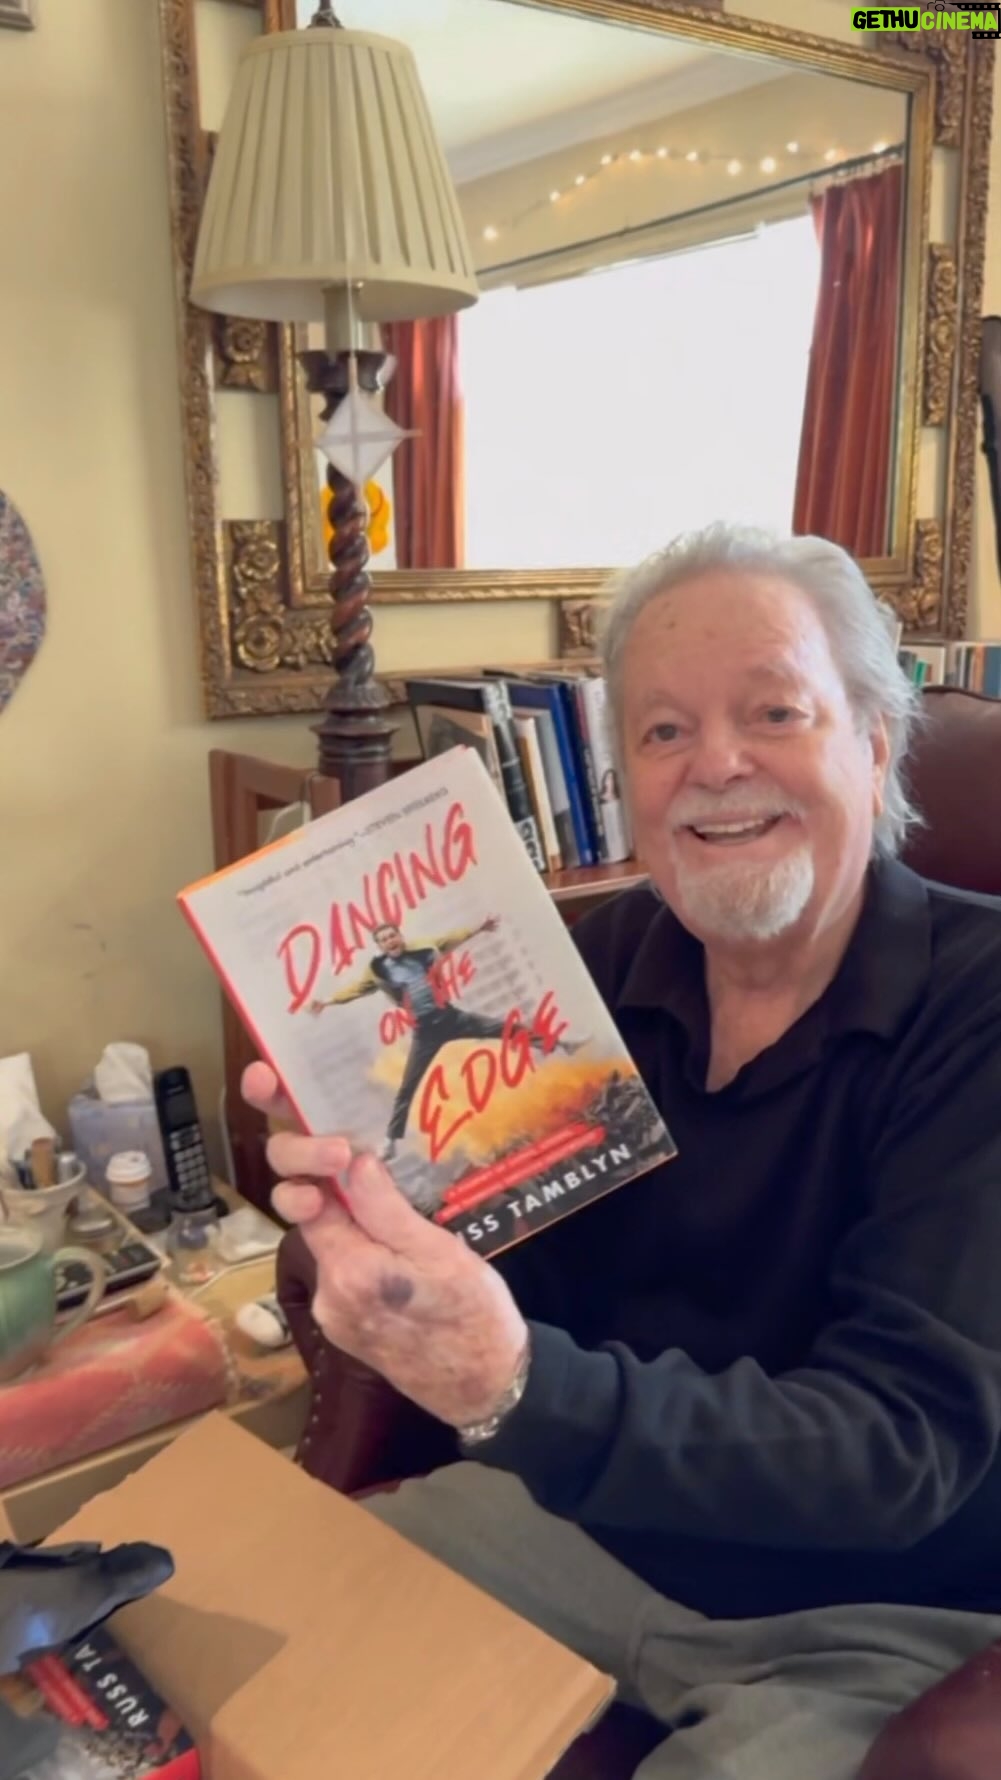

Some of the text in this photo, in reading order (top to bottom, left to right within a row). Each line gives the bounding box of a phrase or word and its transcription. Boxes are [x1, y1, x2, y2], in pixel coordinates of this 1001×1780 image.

[277, 802, 479, 1014] DANCING
[379, 950, 478, 1045] ON THE
[420, 990, 569, 1164] EDGE
[507, 1143, 632, 1217] TAMBLYN
[97, 1672, 150, 1729] RUSS
